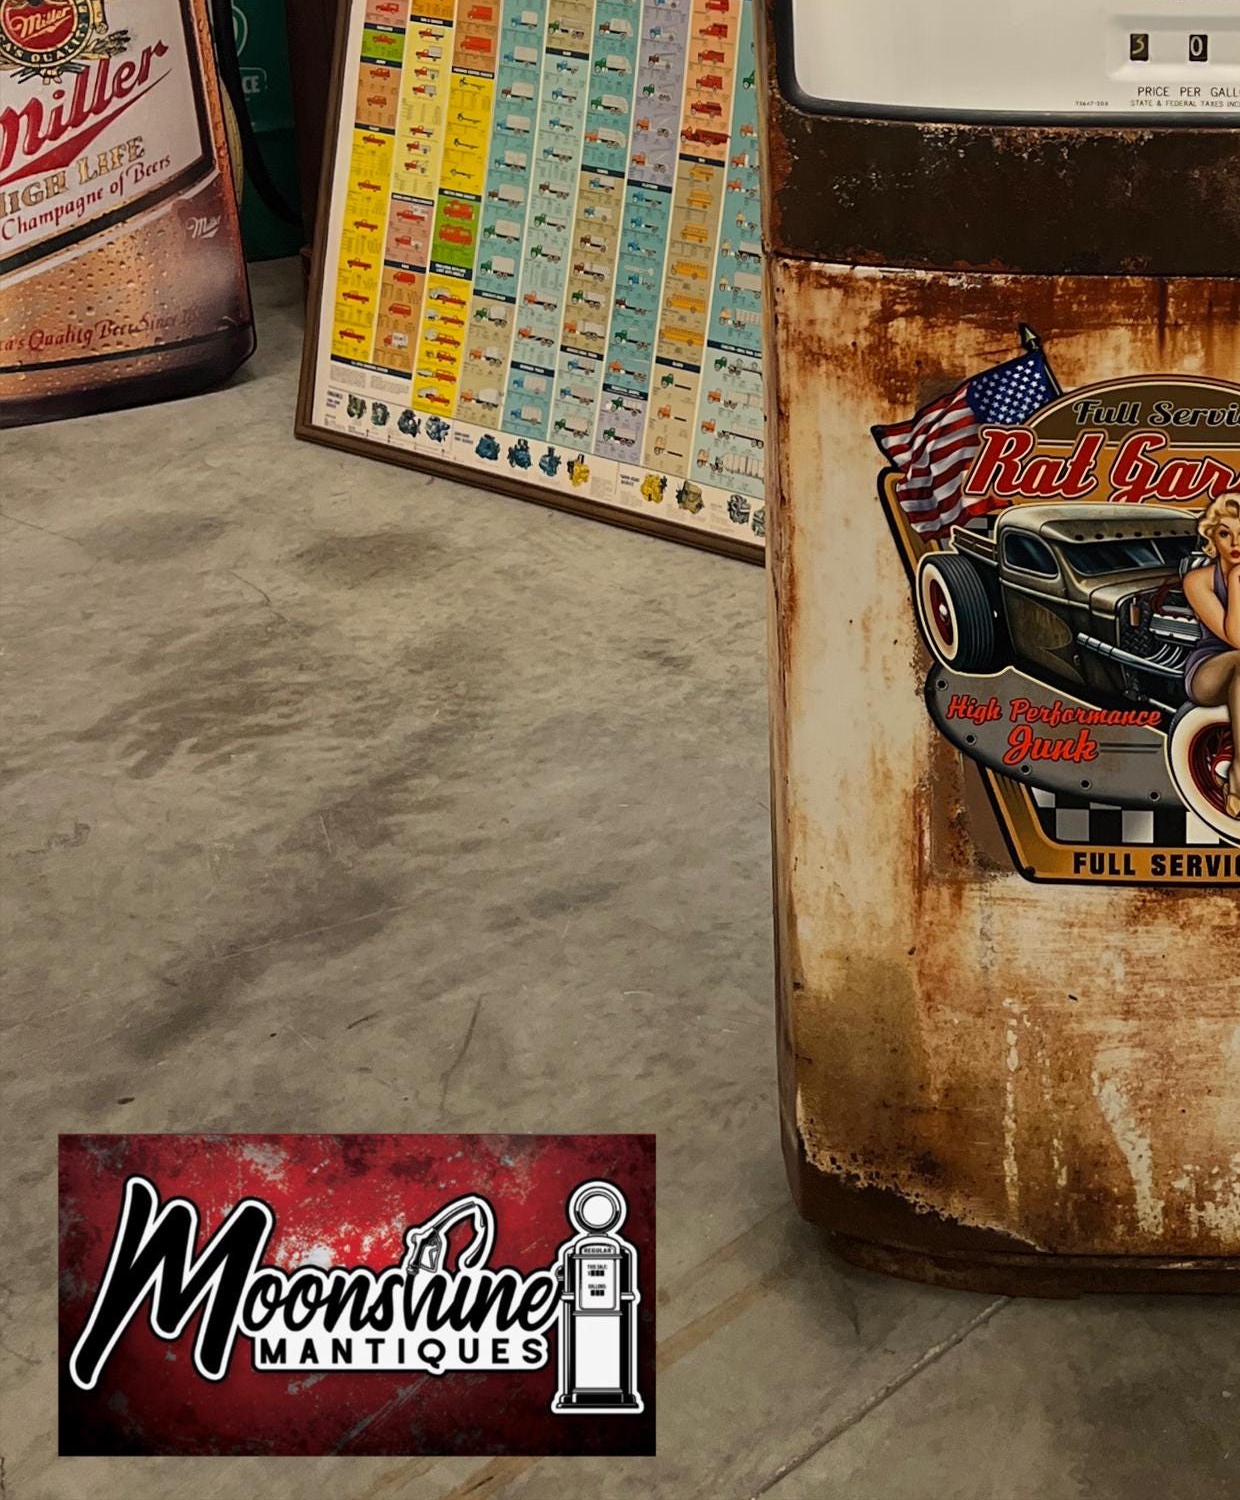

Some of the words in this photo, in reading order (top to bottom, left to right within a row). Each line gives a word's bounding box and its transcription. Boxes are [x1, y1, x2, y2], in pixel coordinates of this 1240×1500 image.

[9, 6, 72, 42] Miller
[1138, 86, 1170, 97] PRICE
[1180, 87, 1201, 97] PER
[1201, 100, 1224, 108] TAXES
[77, 136, 146, 184] LIFE
[1, 186, 104, 241] Champagne
[109, 171, 125, 199] of
[125, 155, 171, 185] Beers
[1072, 400, 1139, 426] Full
[964, 429, 1104, 496] Rat
[946, 695, 1002, 726] High
[1009, 698, 1162, 729] Performance
[1003, 727, 1100, 766] Junk
[1072, 850, 1137, 878] FULL
